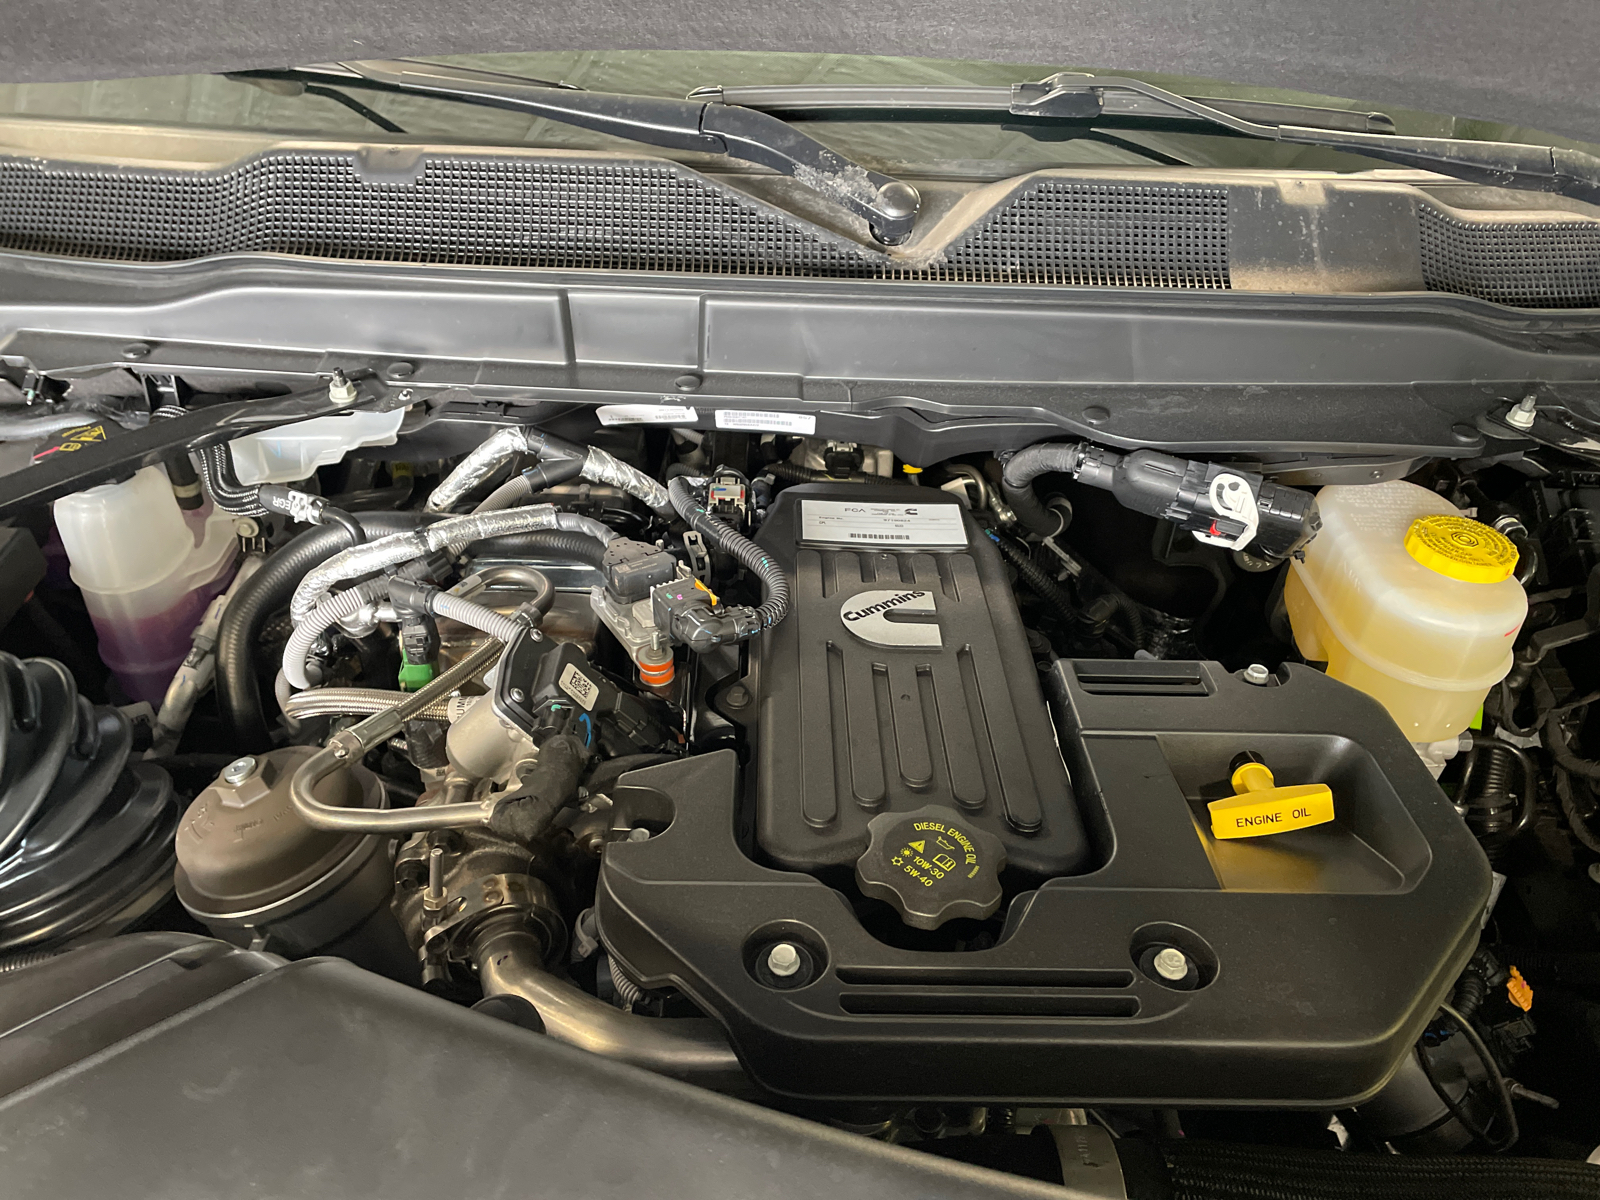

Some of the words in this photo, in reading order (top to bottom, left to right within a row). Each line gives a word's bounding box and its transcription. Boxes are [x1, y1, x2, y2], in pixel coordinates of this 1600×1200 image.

[273, 496, 291, 510] EGR
[843, 591, 926, 622] Cummins
[1236, 812, 1283, 828] ENGINE
[1292, 807, 1312, 819] OIL
[913, 822, 946, 833] DIESEL
[946, 828, 975, 853] ENGINE
[965, 853, 977, 865] OIL
[903, 865, 934, 887] 5W-40
[913, 856, 945, 880] 10W-30
